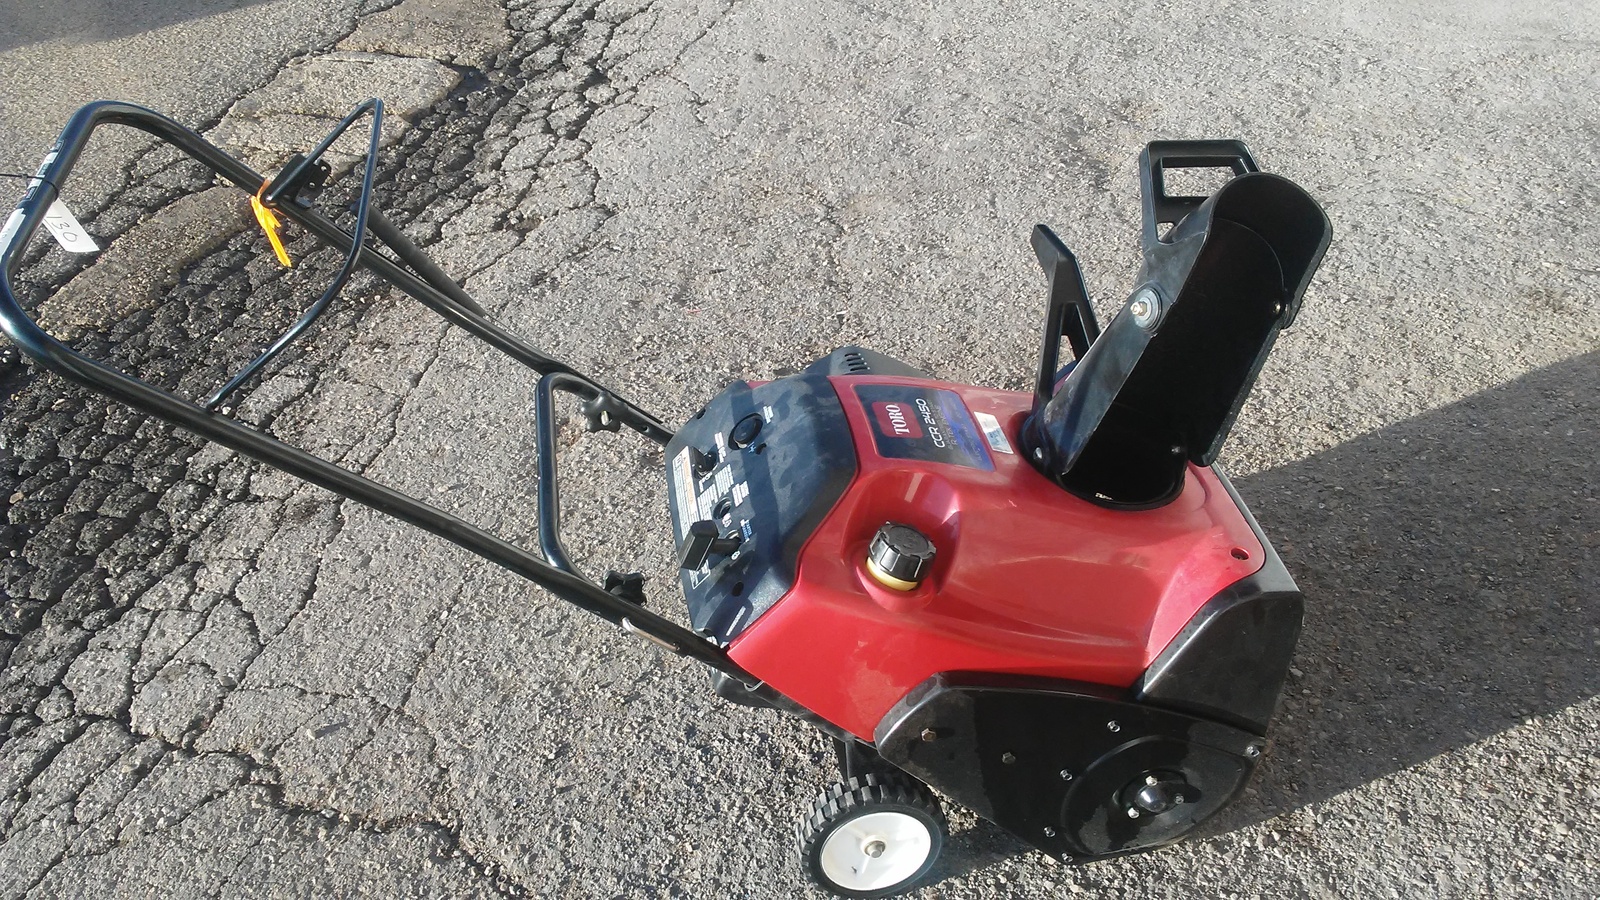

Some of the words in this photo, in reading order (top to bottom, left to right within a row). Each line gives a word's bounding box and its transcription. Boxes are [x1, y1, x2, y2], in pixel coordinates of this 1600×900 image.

[45, 215, 78, 243] 130
[885, 404, 910, 435] TORO
[915, 398, 936, 425] 2450
[928, 426, 946, 448] CCR
